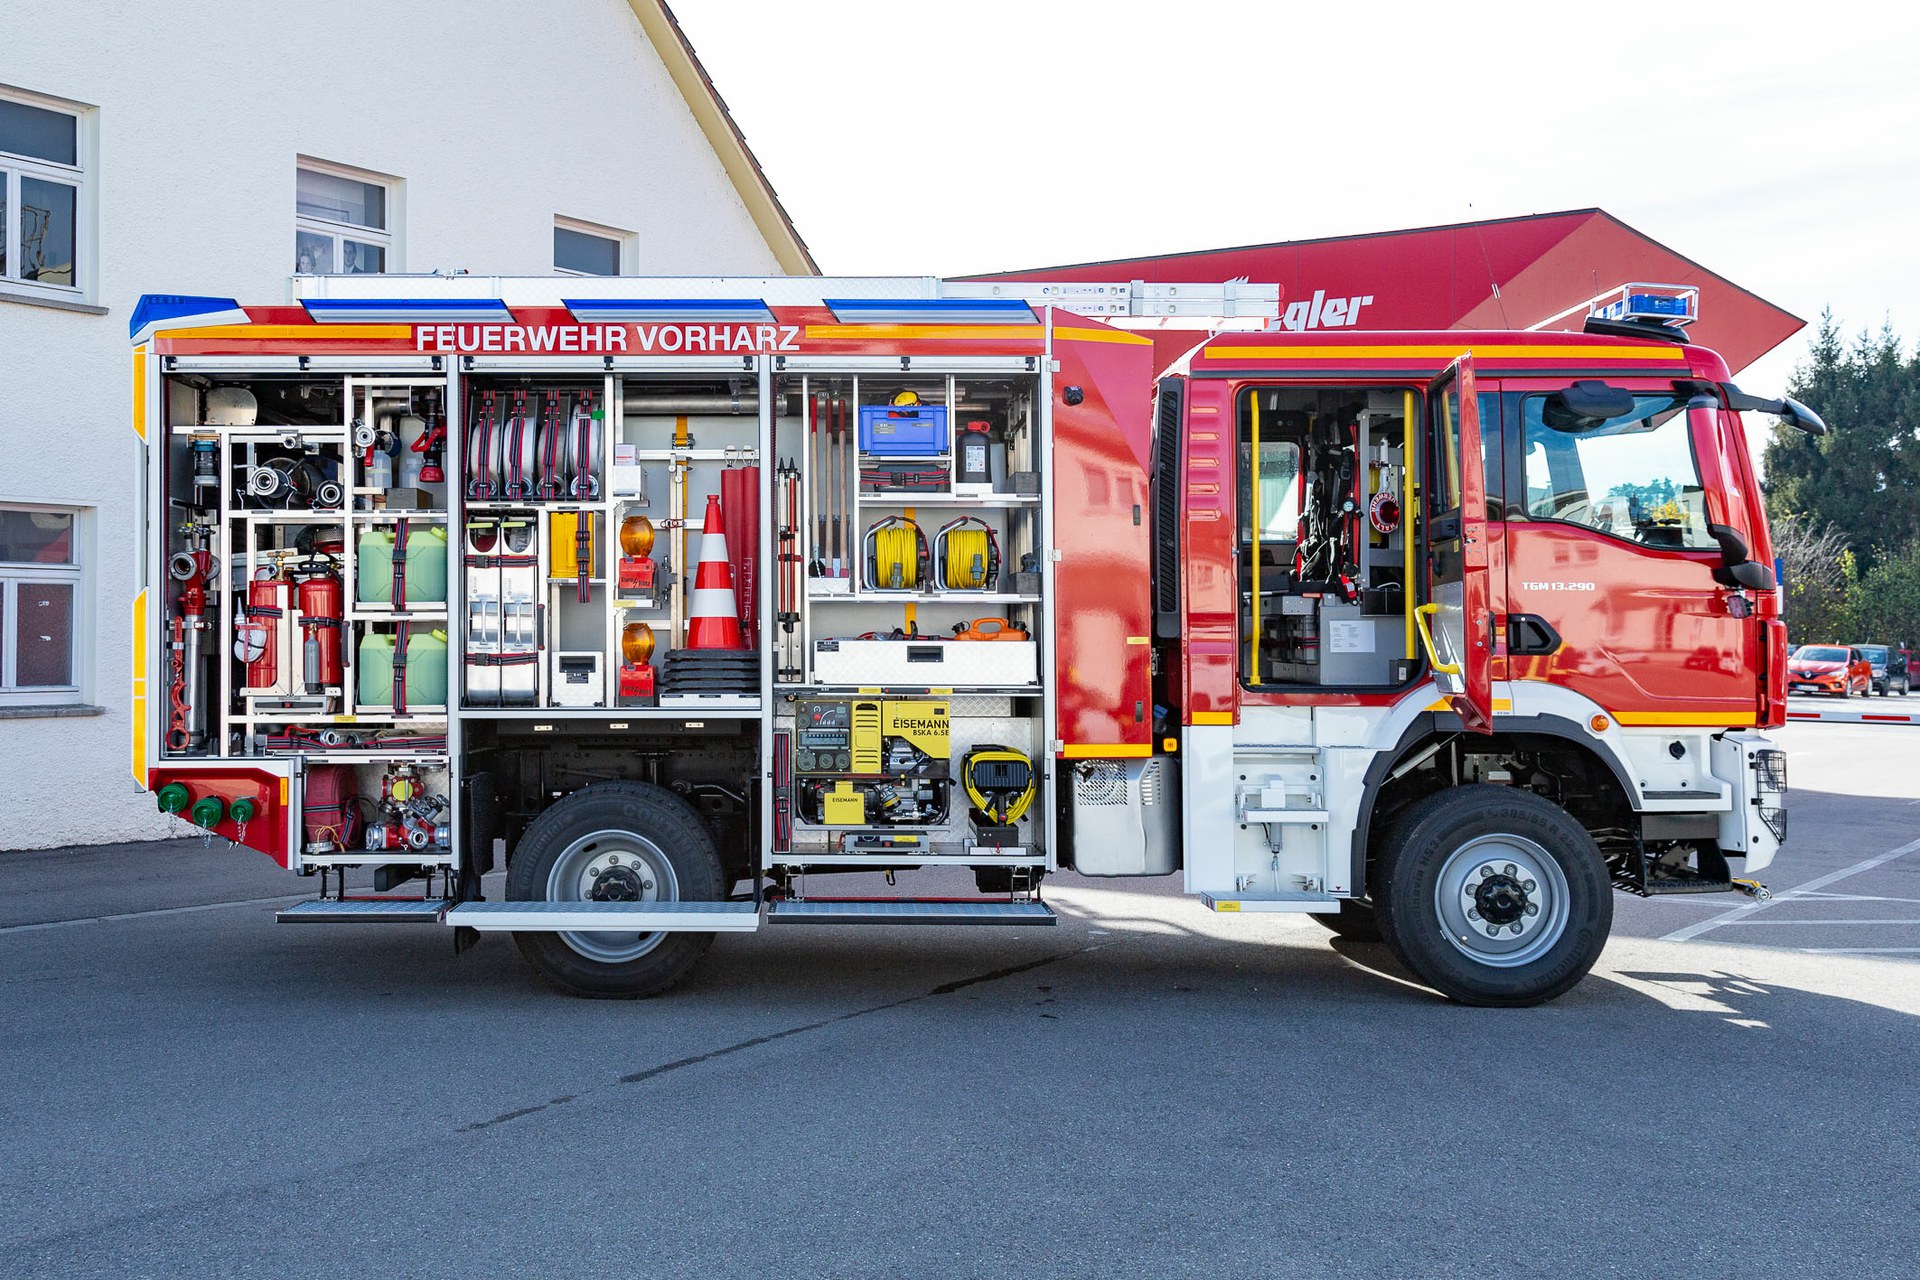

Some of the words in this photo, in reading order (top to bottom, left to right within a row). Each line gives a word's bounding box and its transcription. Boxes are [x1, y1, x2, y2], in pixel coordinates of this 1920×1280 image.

[417, 325, 627, 351] FEUERWEHR
[637, 325, 800, 351] VORHARZ
[1376, 522, 1396, 531] HALT
[1522, 582, 1549, 591] TGM
[1551, 582, 1595, 591] 13.290
[893, 719, 949, 729] EISEMANN
